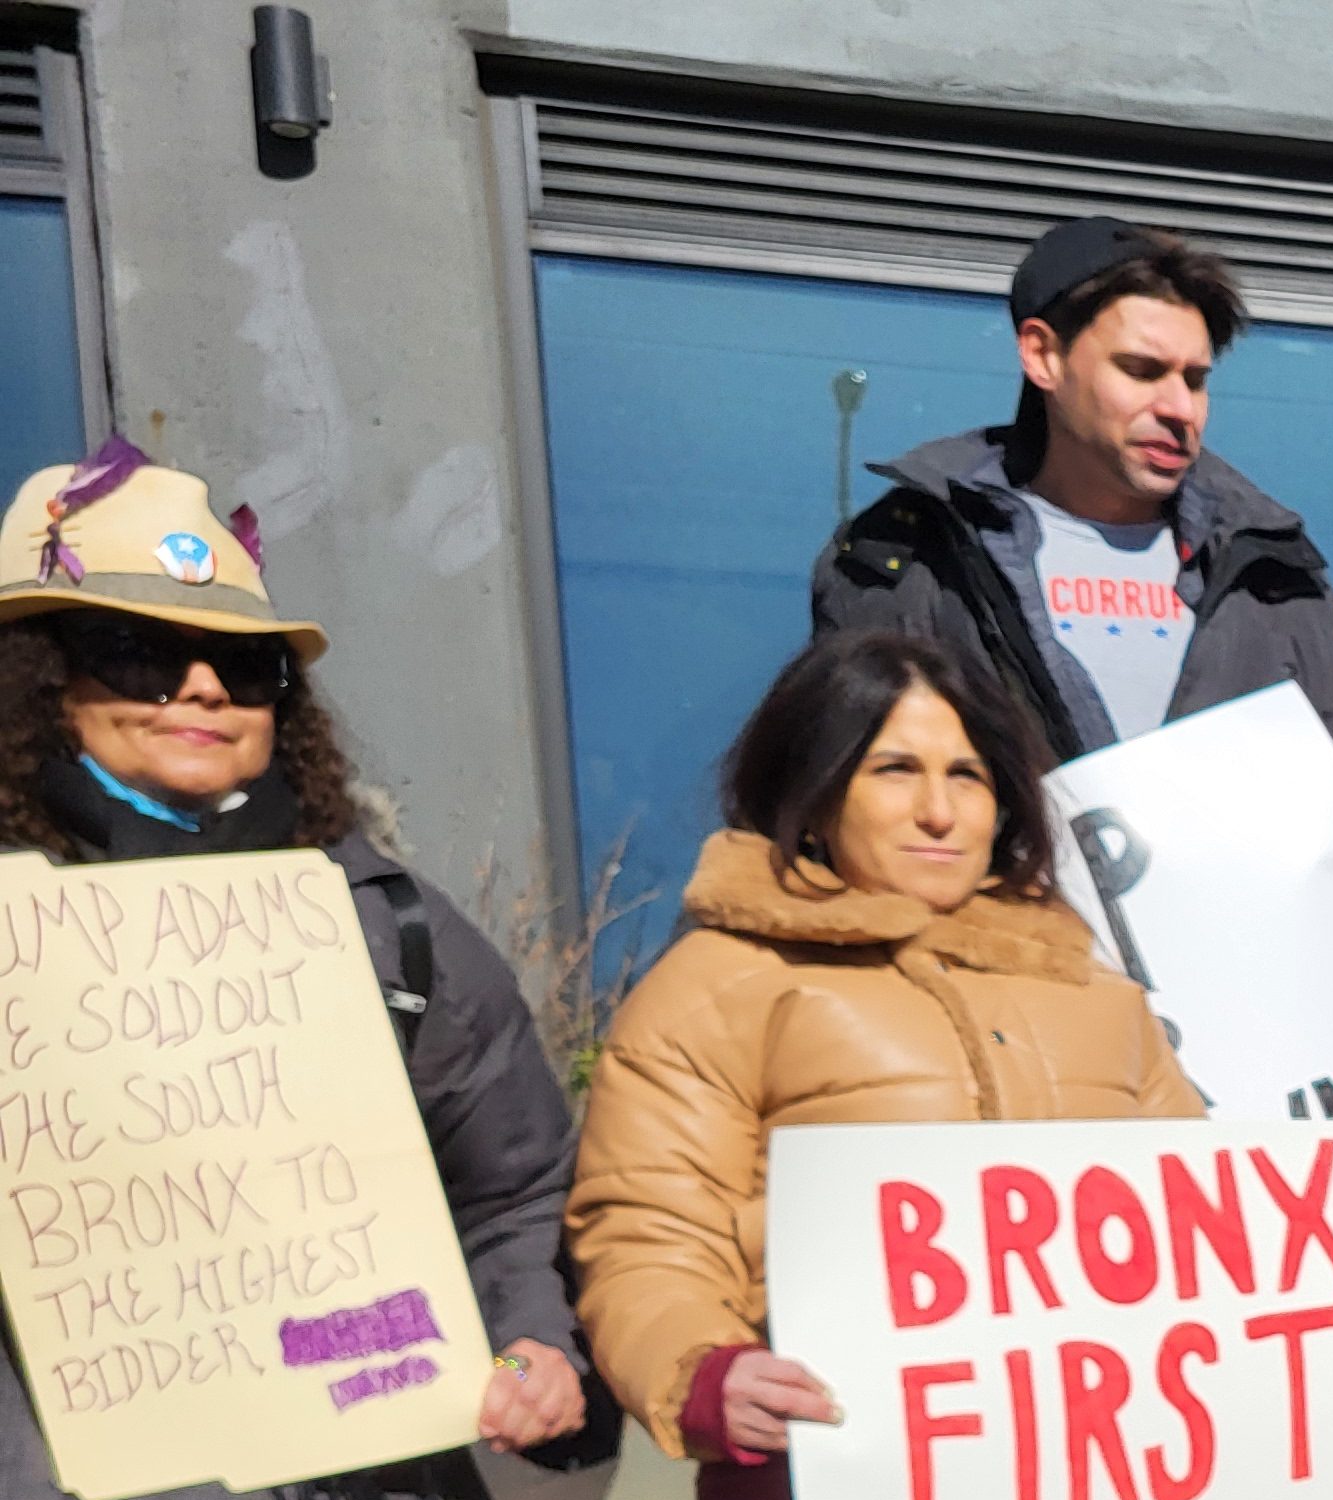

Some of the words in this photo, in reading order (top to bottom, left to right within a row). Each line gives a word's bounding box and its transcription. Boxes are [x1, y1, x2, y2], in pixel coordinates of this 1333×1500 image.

[117, 1044, 298, 1146] SOUTH
[9, 1160, 269, 1269] BRONX
[274, 1142, 358, 1213] TO
[34, 1266, 161, 1341] THE
[176, 1211, 379, 1323] HIGHEST
